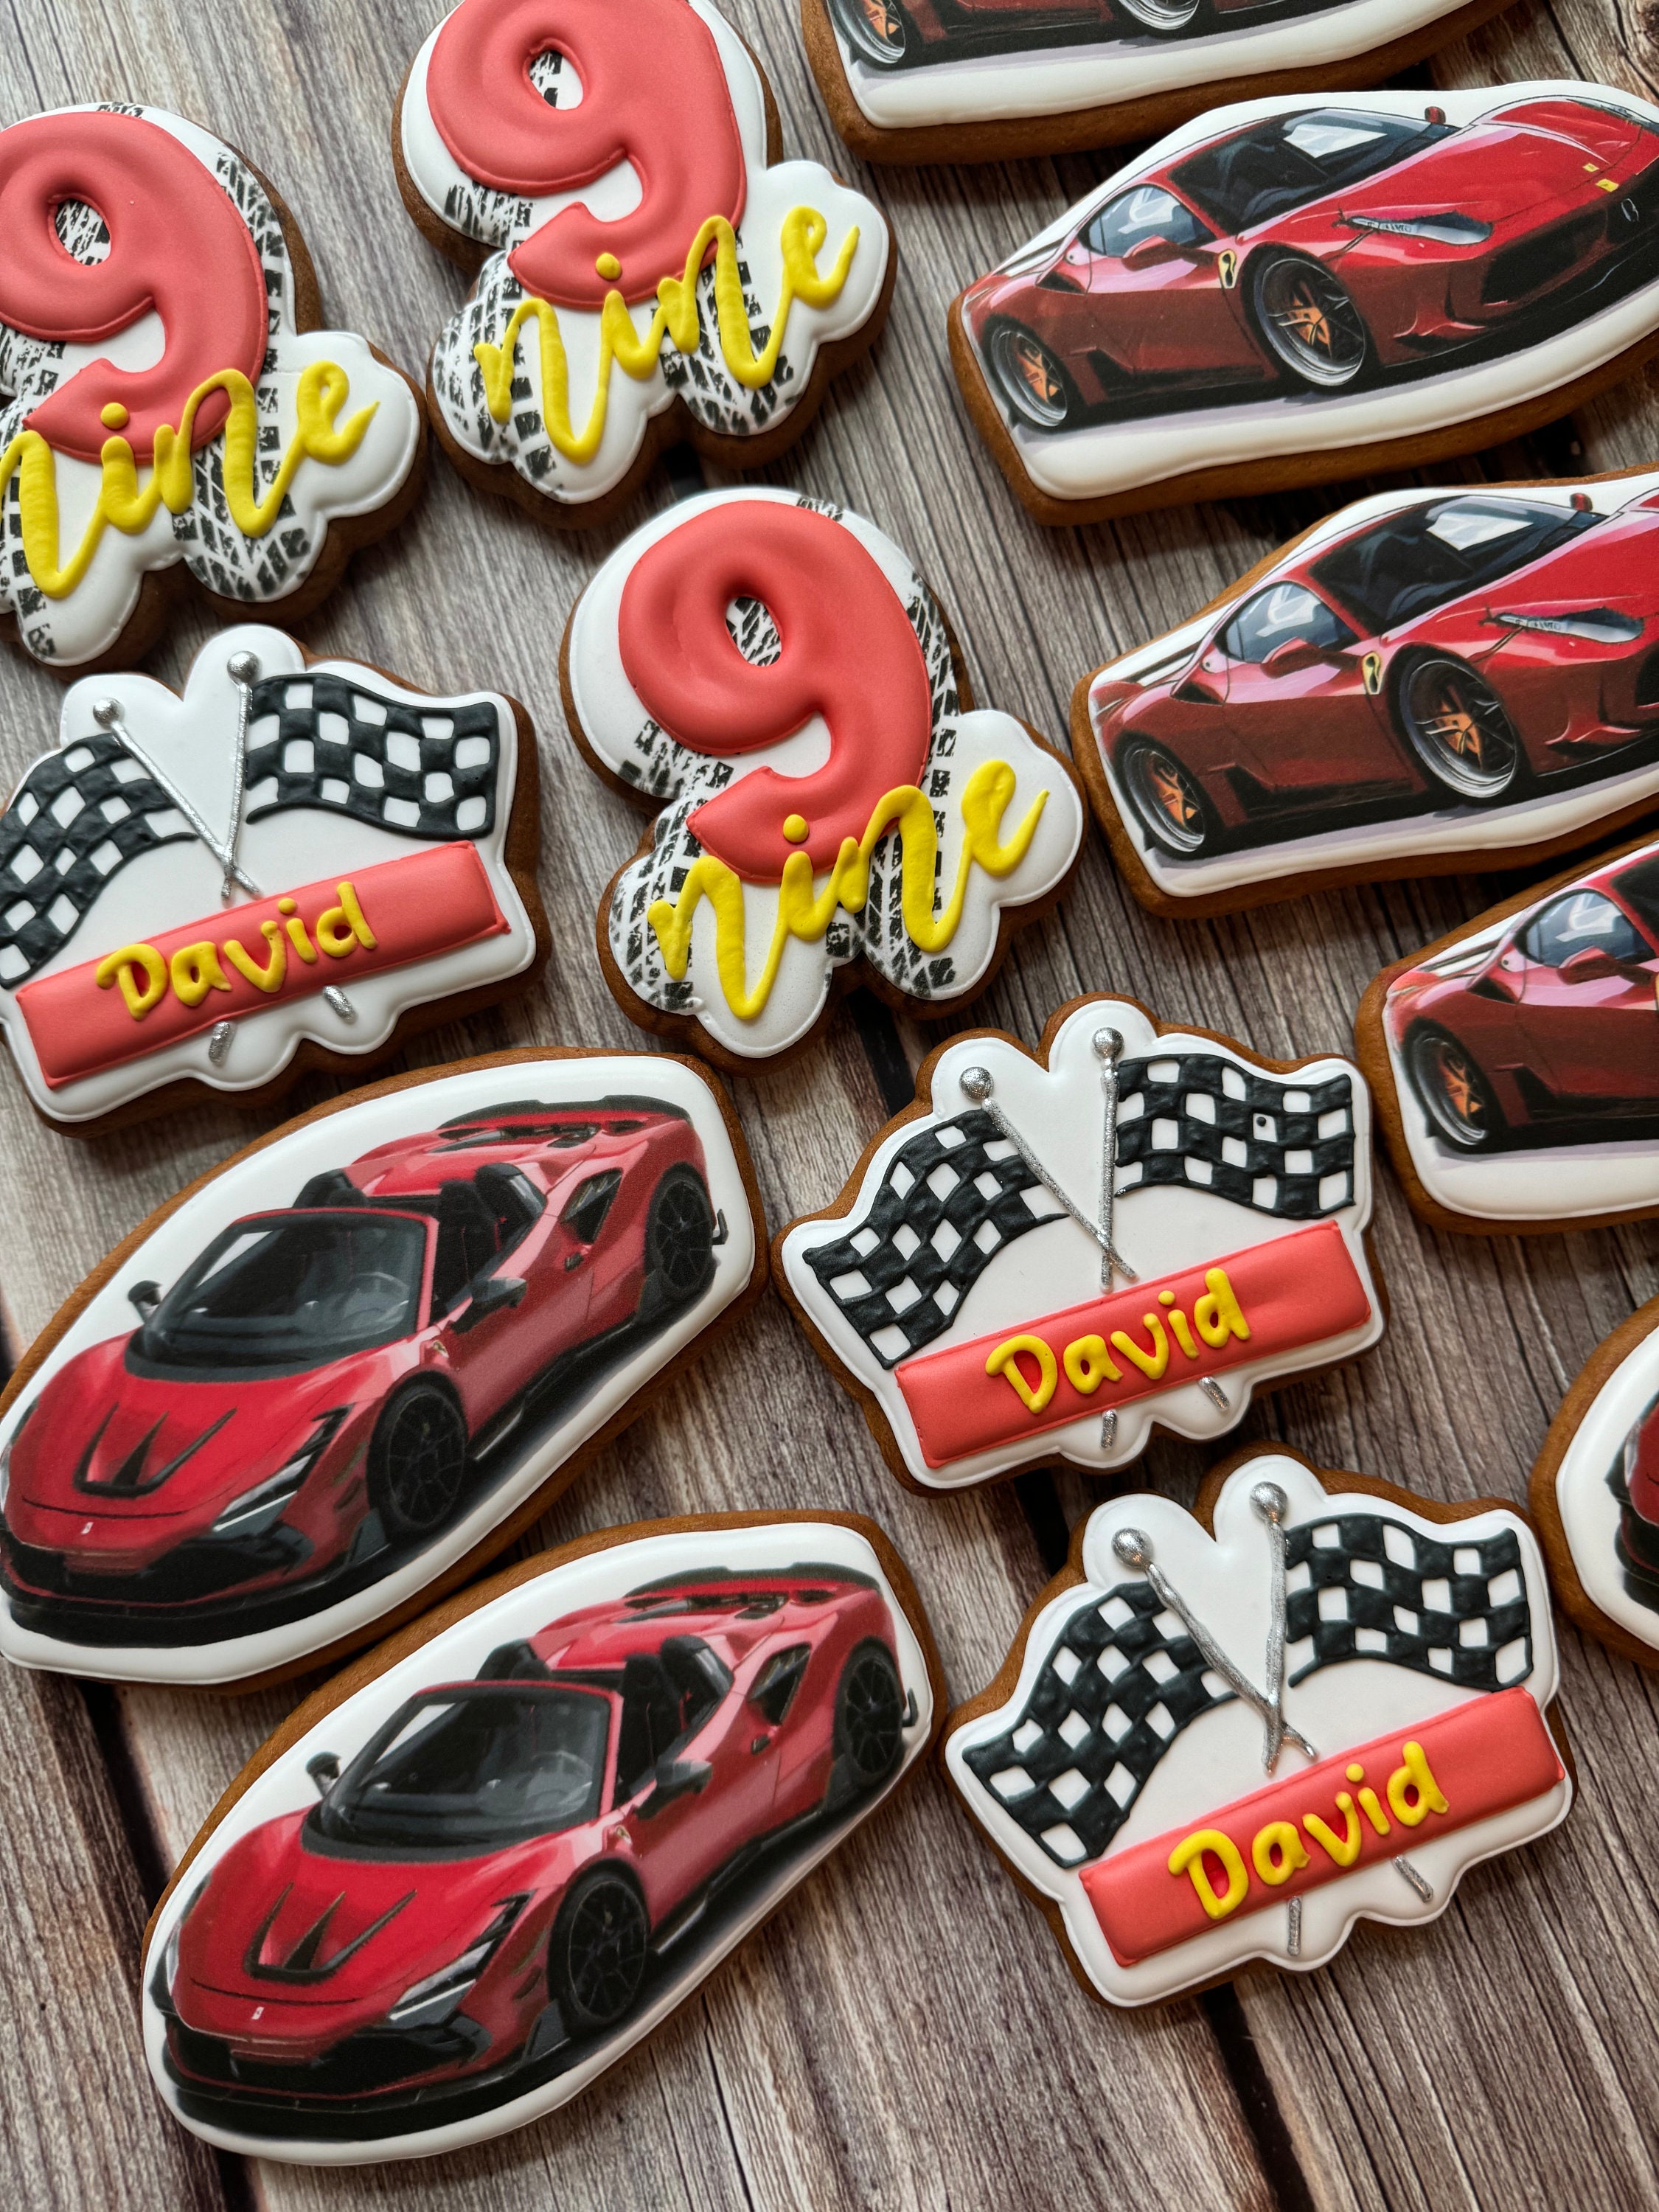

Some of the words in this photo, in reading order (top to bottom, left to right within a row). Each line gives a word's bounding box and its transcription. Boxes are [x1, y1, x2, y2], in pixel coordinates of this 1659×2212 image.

[426, 0, 747, 310] 9
[0, 111, 268, 463] 9
[474, 206, 860, 464] nine
[619, 499, 932, 884] 9
[96, 881, 378, 1020] David
[647, 760, 1049, 1020] nine
[985, 1267, 1251, 1413] David
[1168, 1741, 1450, 1919] David
